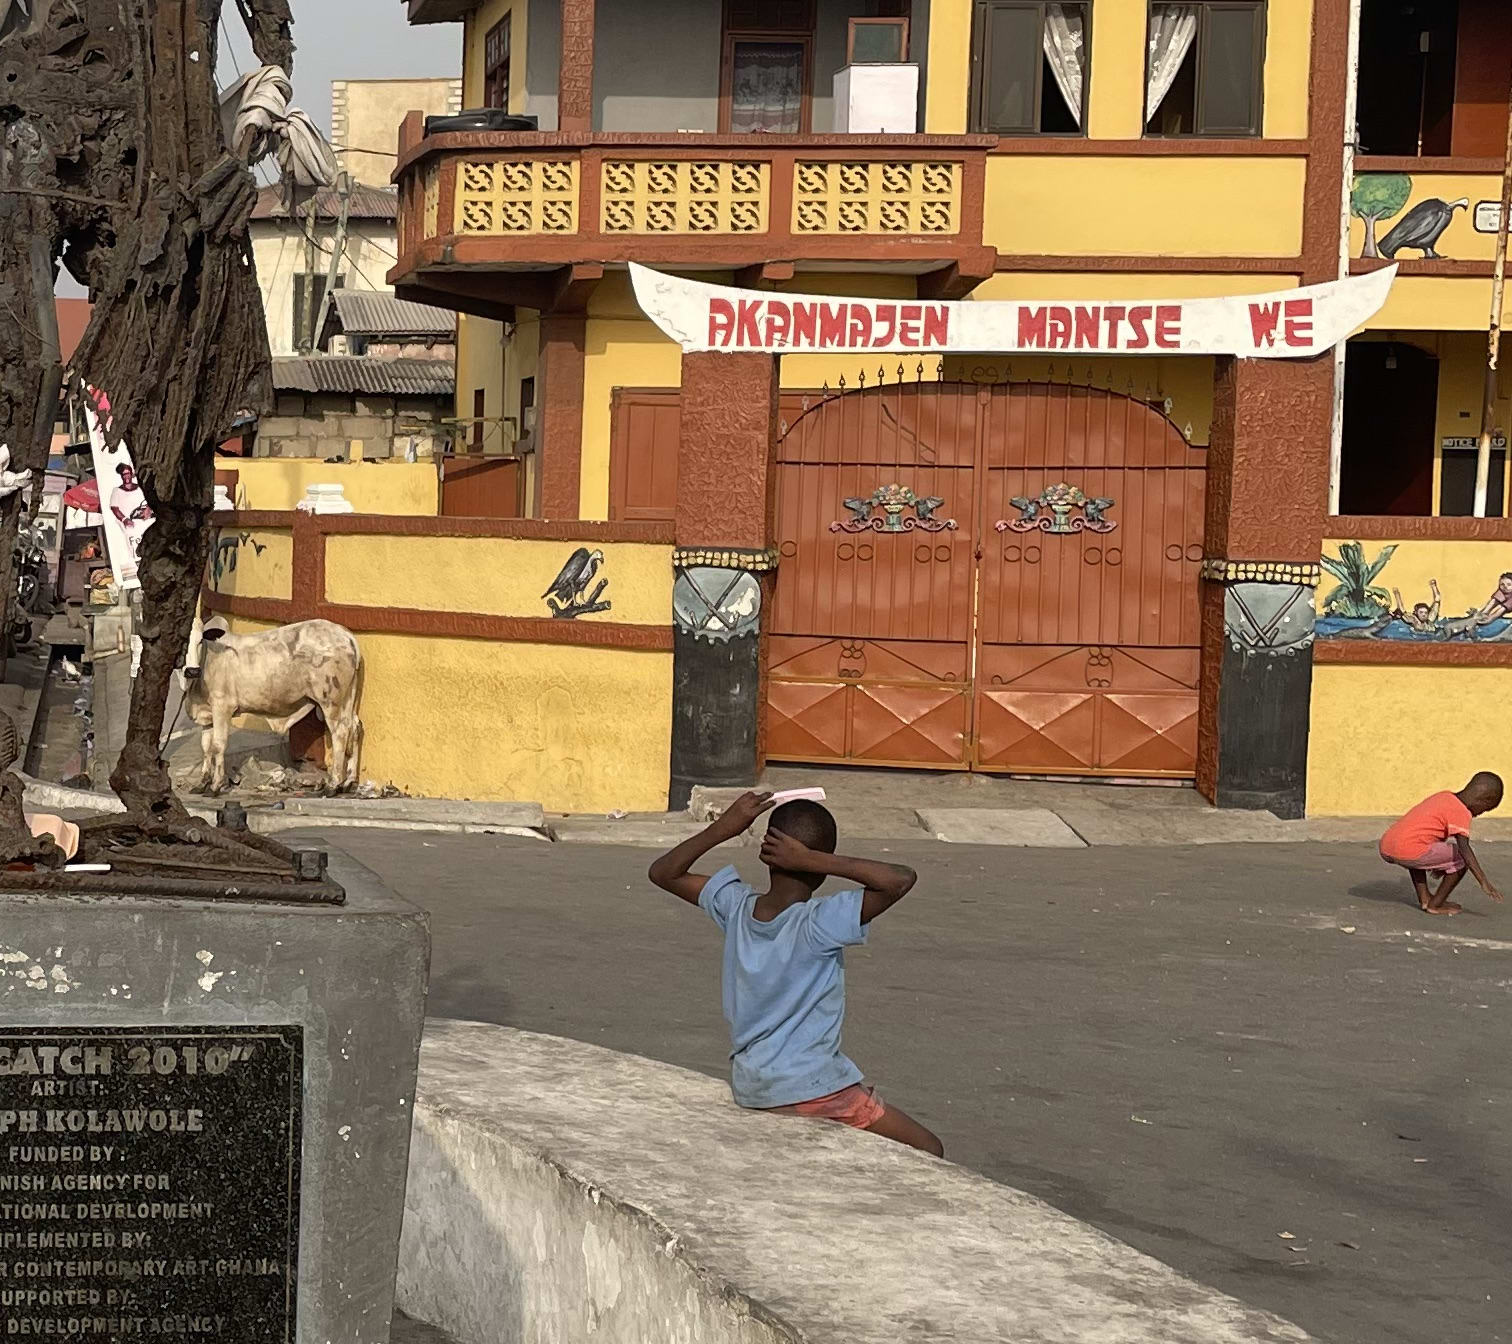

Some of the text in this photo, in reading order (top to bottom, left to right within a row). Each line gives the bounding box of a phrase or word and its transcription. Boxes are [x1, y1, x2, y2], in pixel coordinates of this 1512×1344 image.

[708, 298, 1313, 349] AKANMAJEN MANTSE WE
[30, 1080, 105, 1097] ARTIST:
[45, 1109, 204, 1133] KOLAWOLE
[9, 1146, 84, 1162] FUNDED
[51, 1174, 130, 1191] AGENCY
[134, 1174, 171, 1190] FOR
[77, 1203, 215, 1220] DEVELOPMENT
[122, 1232, 152, 1249] BY:
[13, 1259, 167, 1278] CONTEMPORARY
[7, 1317, 146, 1335] DEVELOPMENT
[149, 1315, 225, 1333] AGENCY
